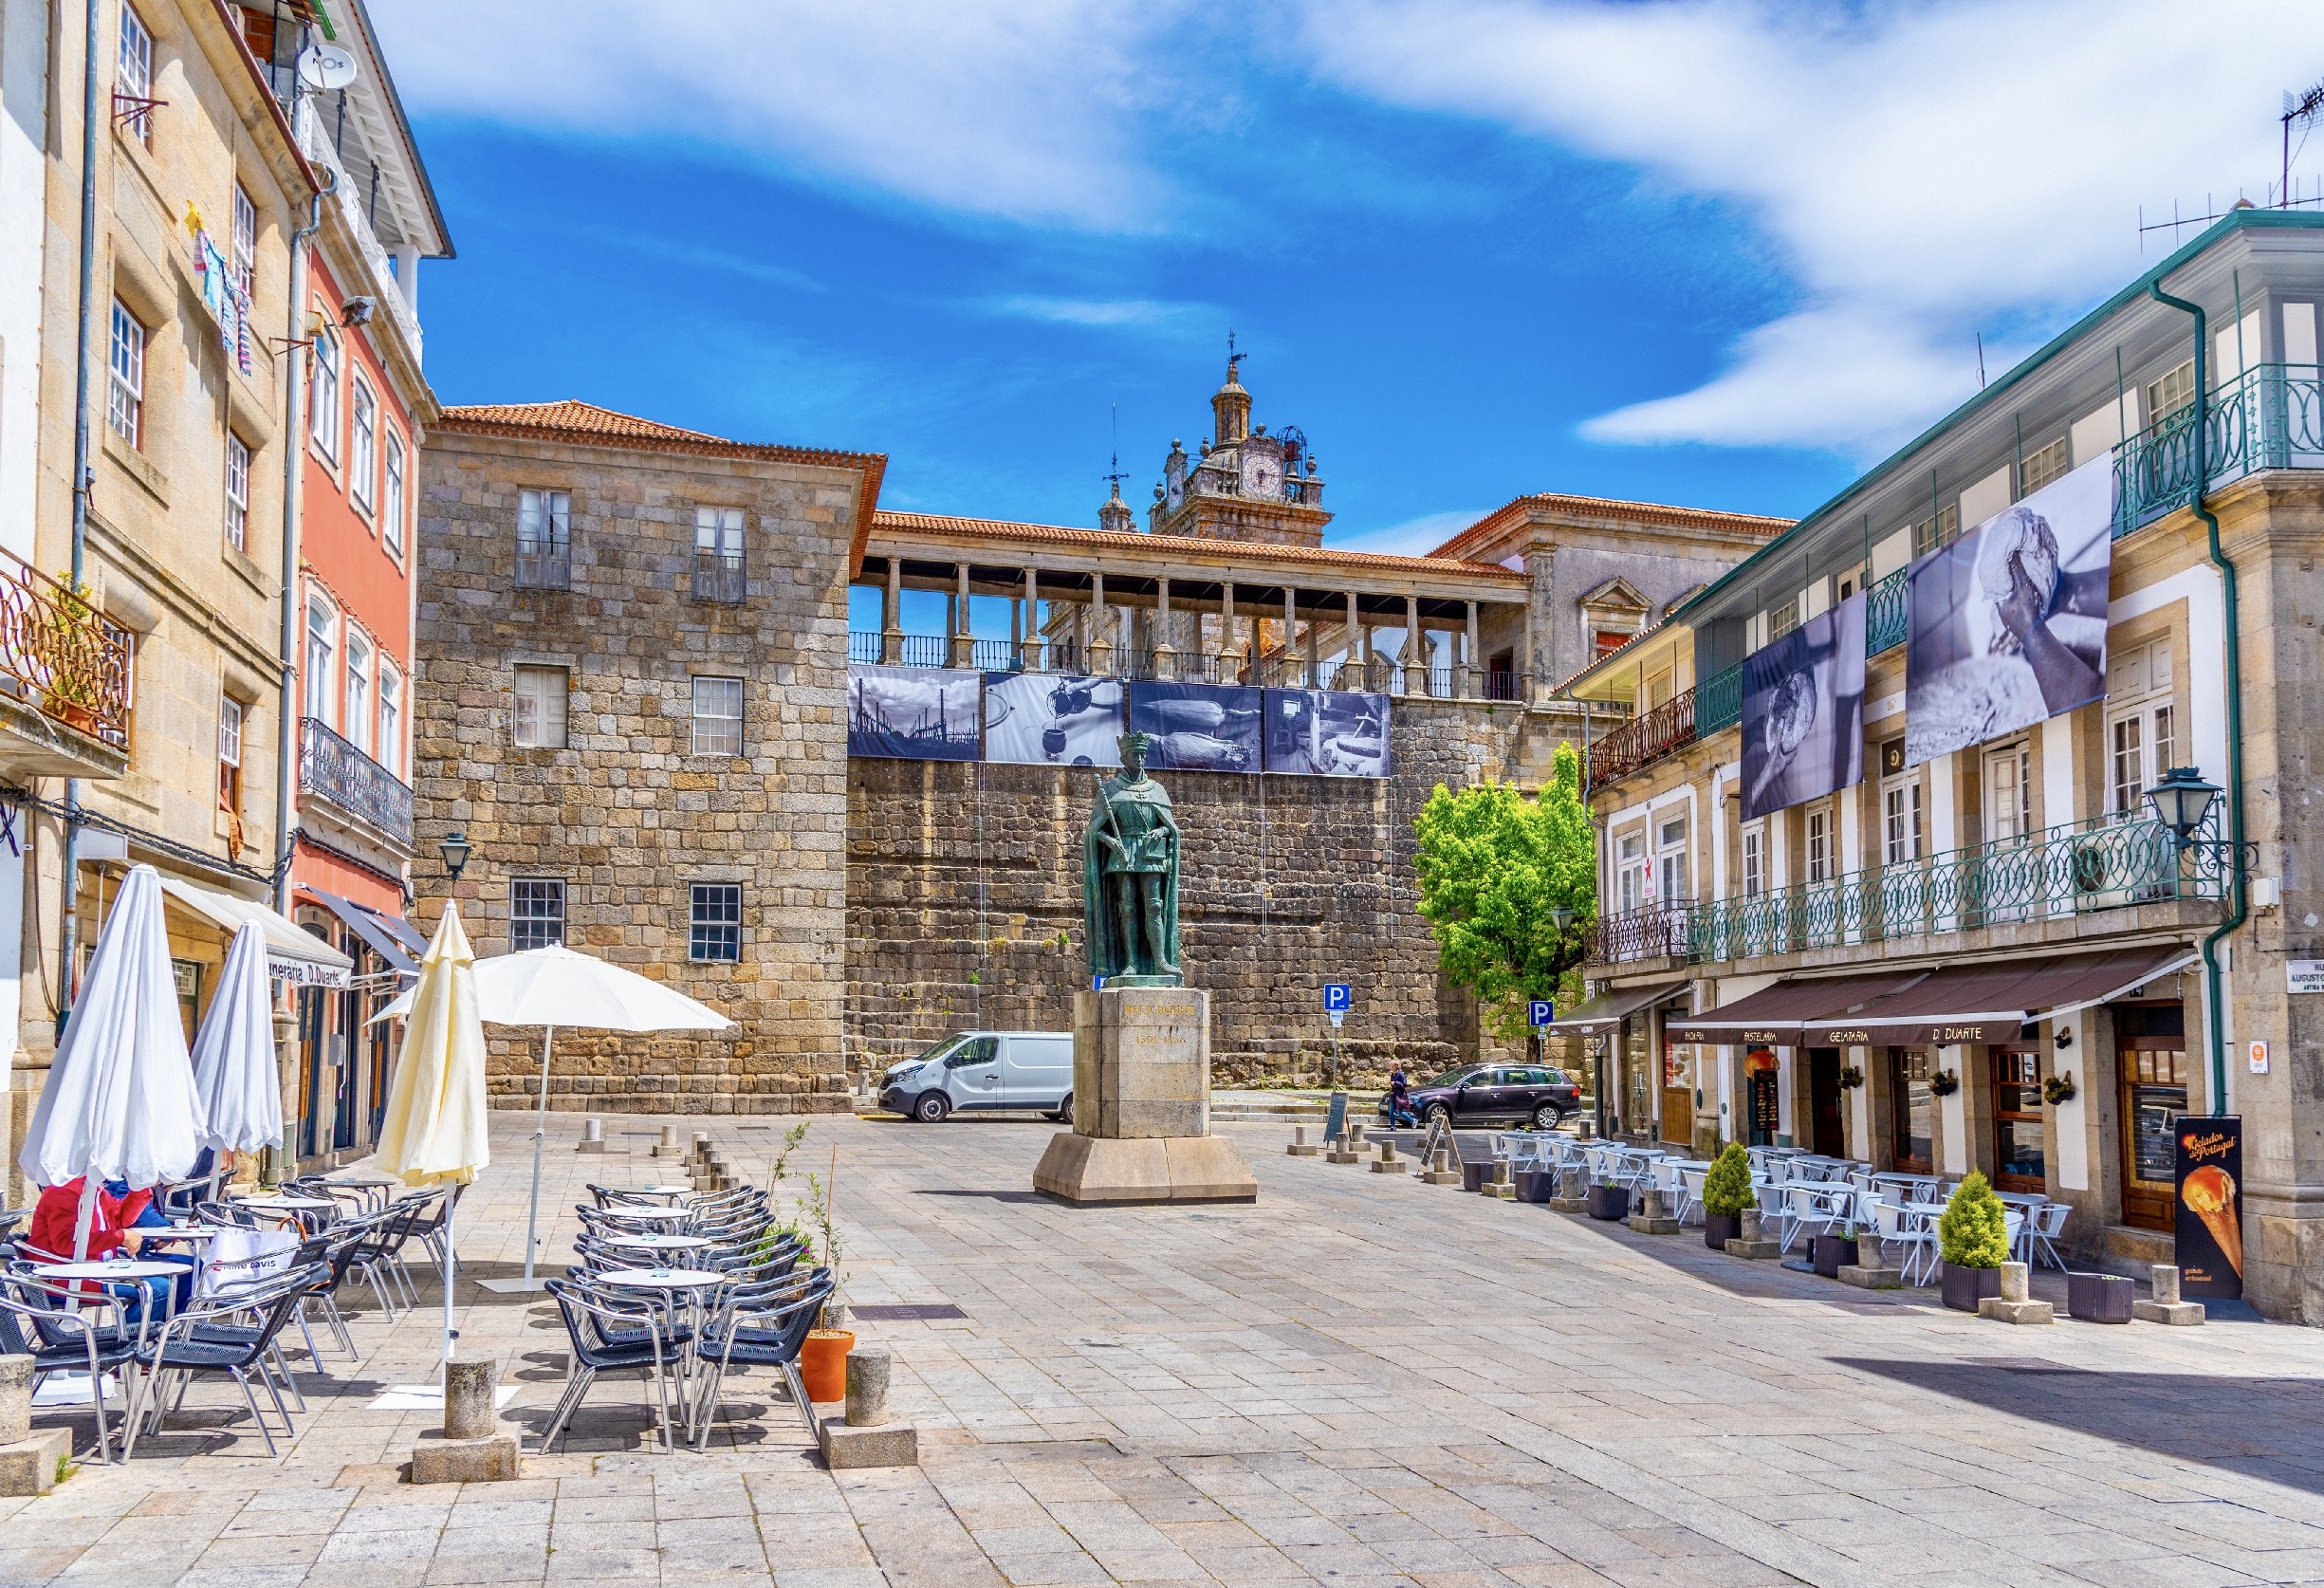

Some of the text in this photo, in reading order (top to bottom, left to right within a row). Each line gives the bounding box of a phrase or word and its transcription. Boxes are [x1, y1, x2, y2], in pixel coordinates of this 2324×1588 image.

[1330, 987, 1344, 1007] P
[1535, 1003, 1549, 1025] P
[1744, 1031, 1777, 1042] PASTELARIA
[1830, 1027, 1982, 1043] GELATARIA D. DUARTE
[2192, 1133, 2223, 1151] Gelados
[2197, 1136, 2235, 1162] Portugal
